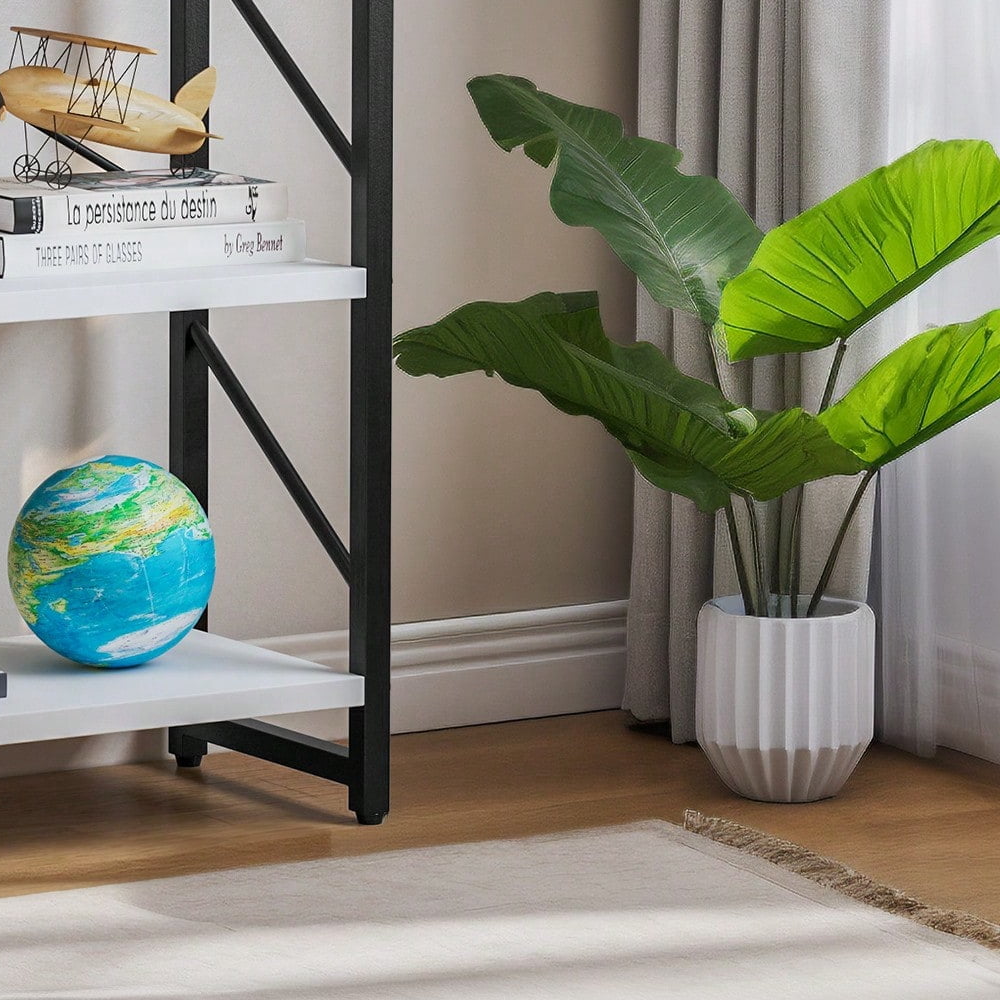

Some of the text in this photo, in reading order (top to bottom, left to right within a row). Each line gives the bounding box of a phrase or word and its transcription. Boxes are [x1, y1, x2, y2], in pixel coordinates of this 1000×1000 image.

[66, 195, 81, 225] La
[84, 194, 156, 231] persistance
[160, 190, 176, 220] du
[181, 189, 217, 218] destin
[36, 241, 143, 267] THREE PAIRS OF GLASSES
[223, 232, 283, 258] by Greg Bennet
